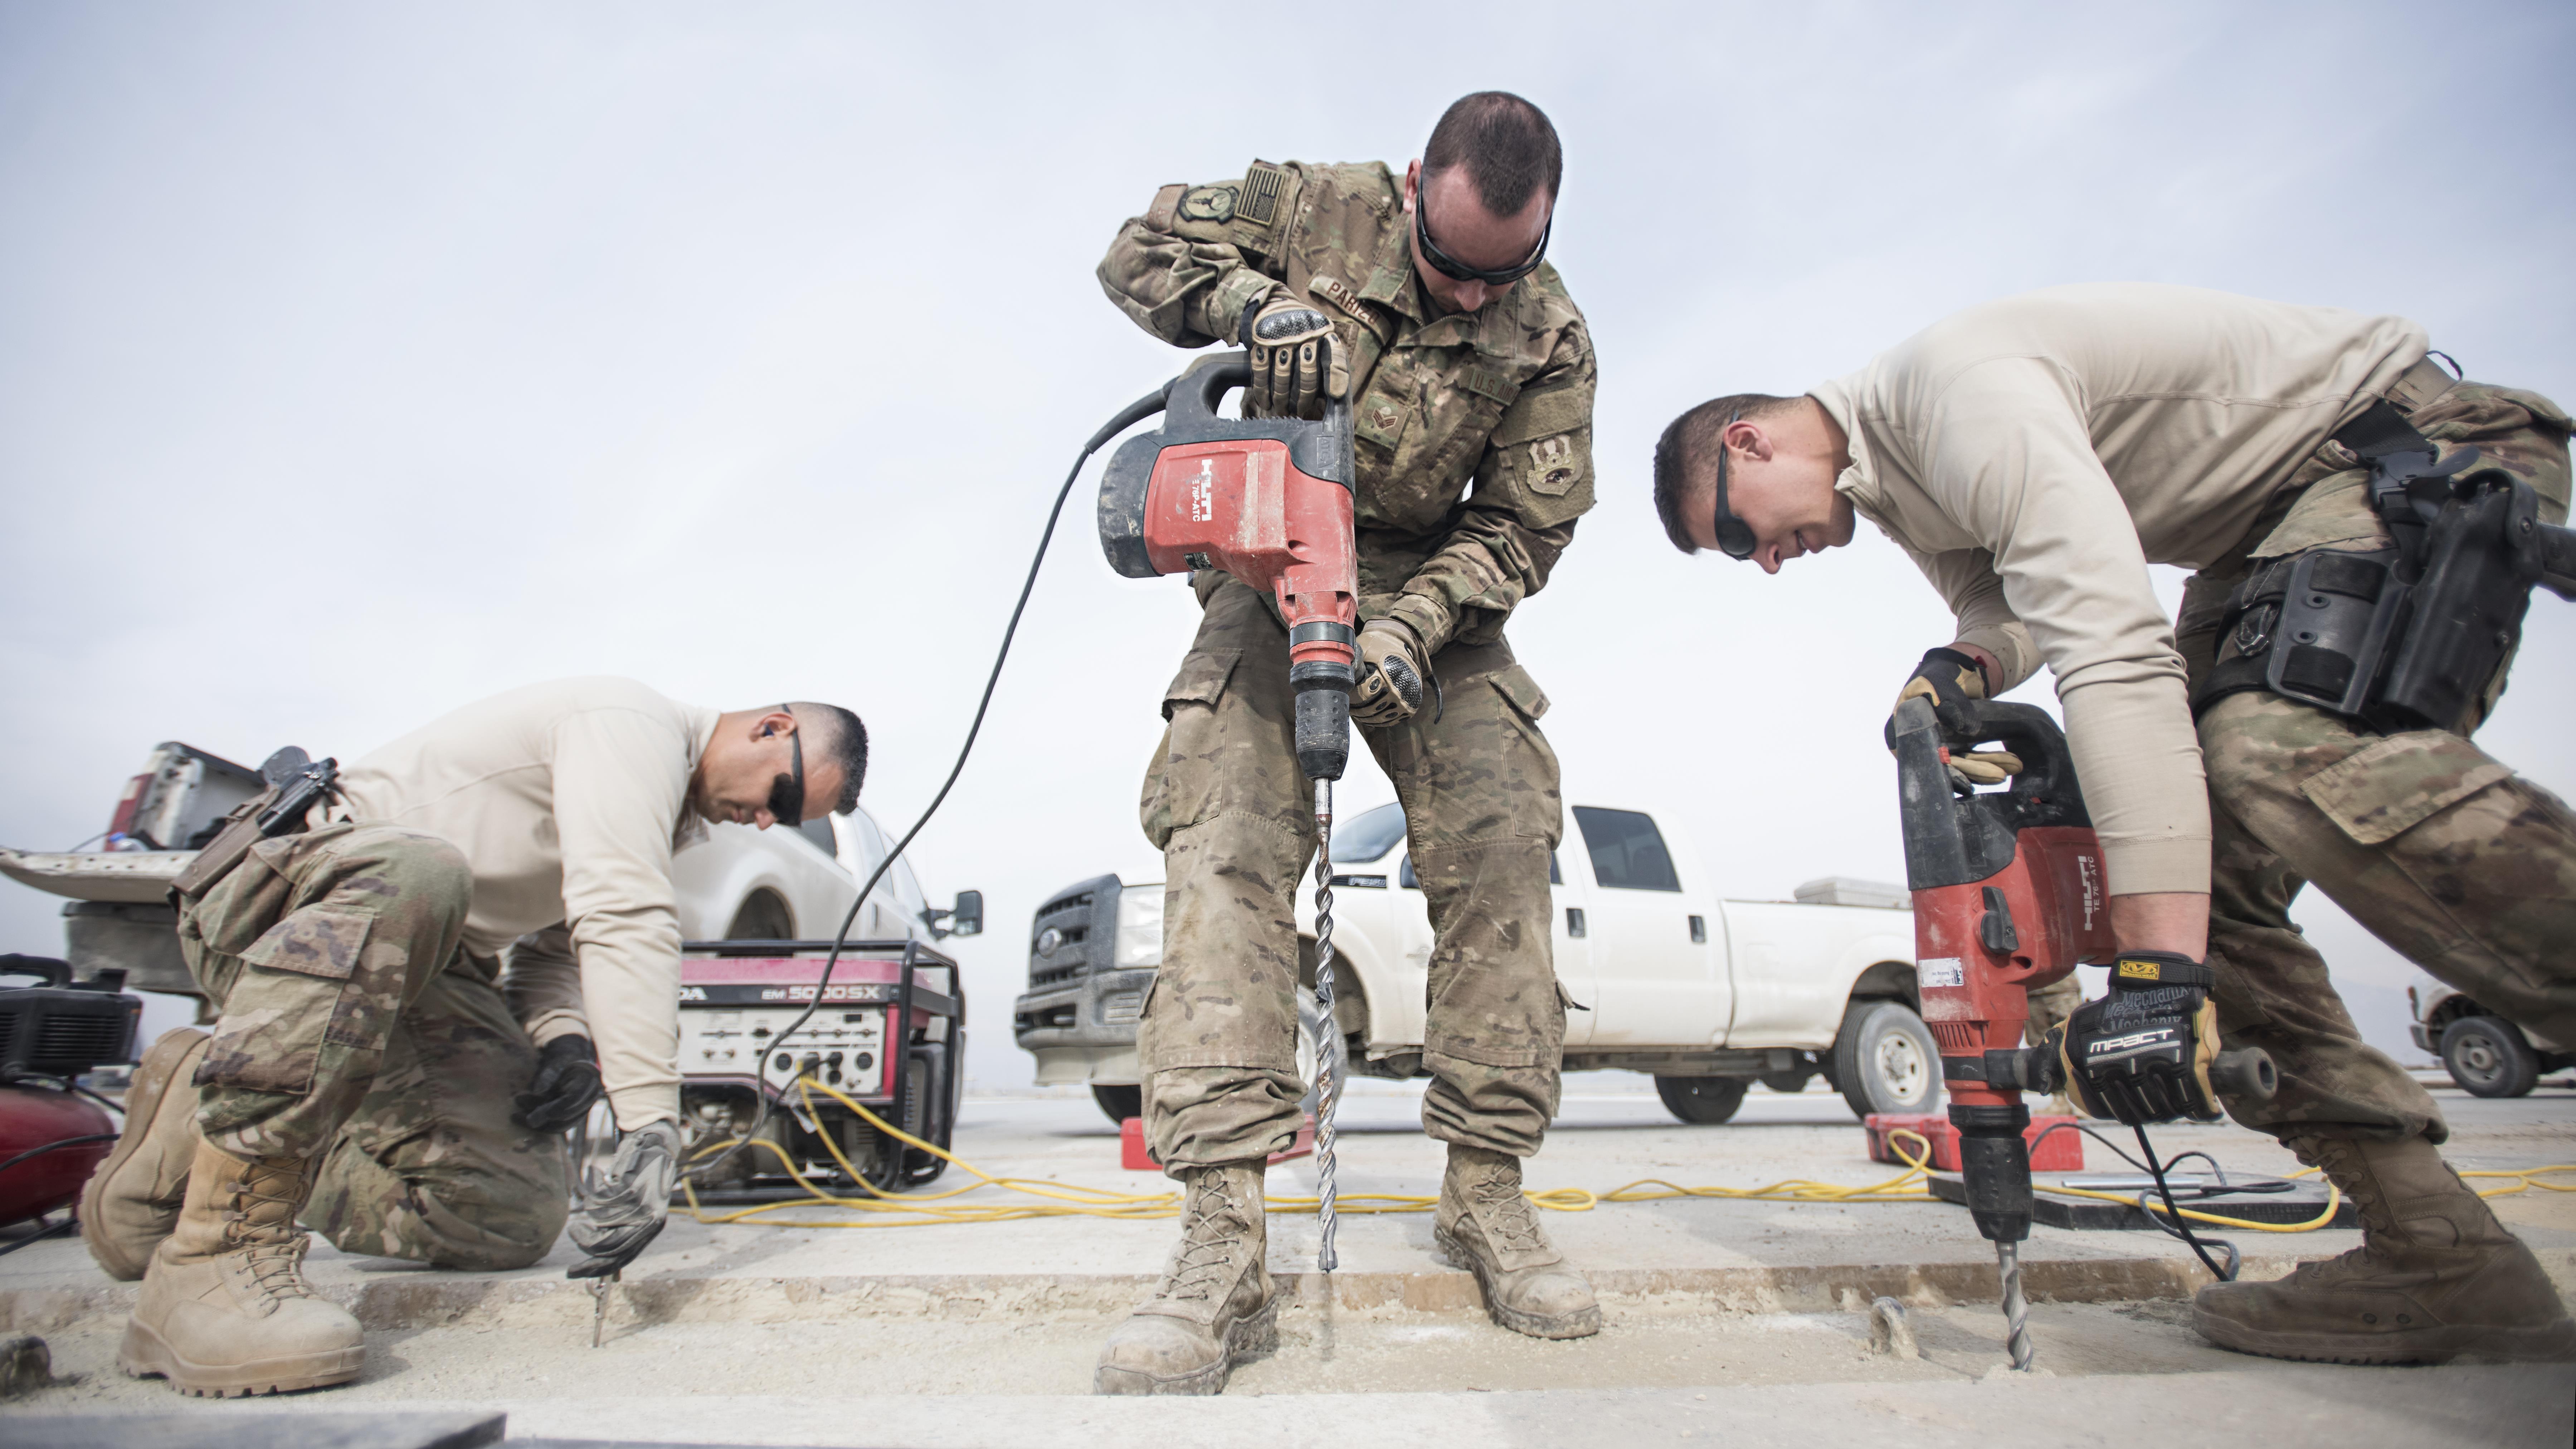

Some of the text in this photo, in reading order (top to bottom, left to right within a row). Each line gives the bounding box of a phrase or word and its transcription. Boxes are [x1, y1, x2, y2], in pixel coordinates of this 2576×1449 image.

[1475, 373, 1495, 396] U.S.
[1201, 459, 1212, 521] HILTI
[2078, 856, 2093, 930] HILTI
[2094, 899, 2100, 912] TE
[761, 989, 786, 1000] EM
